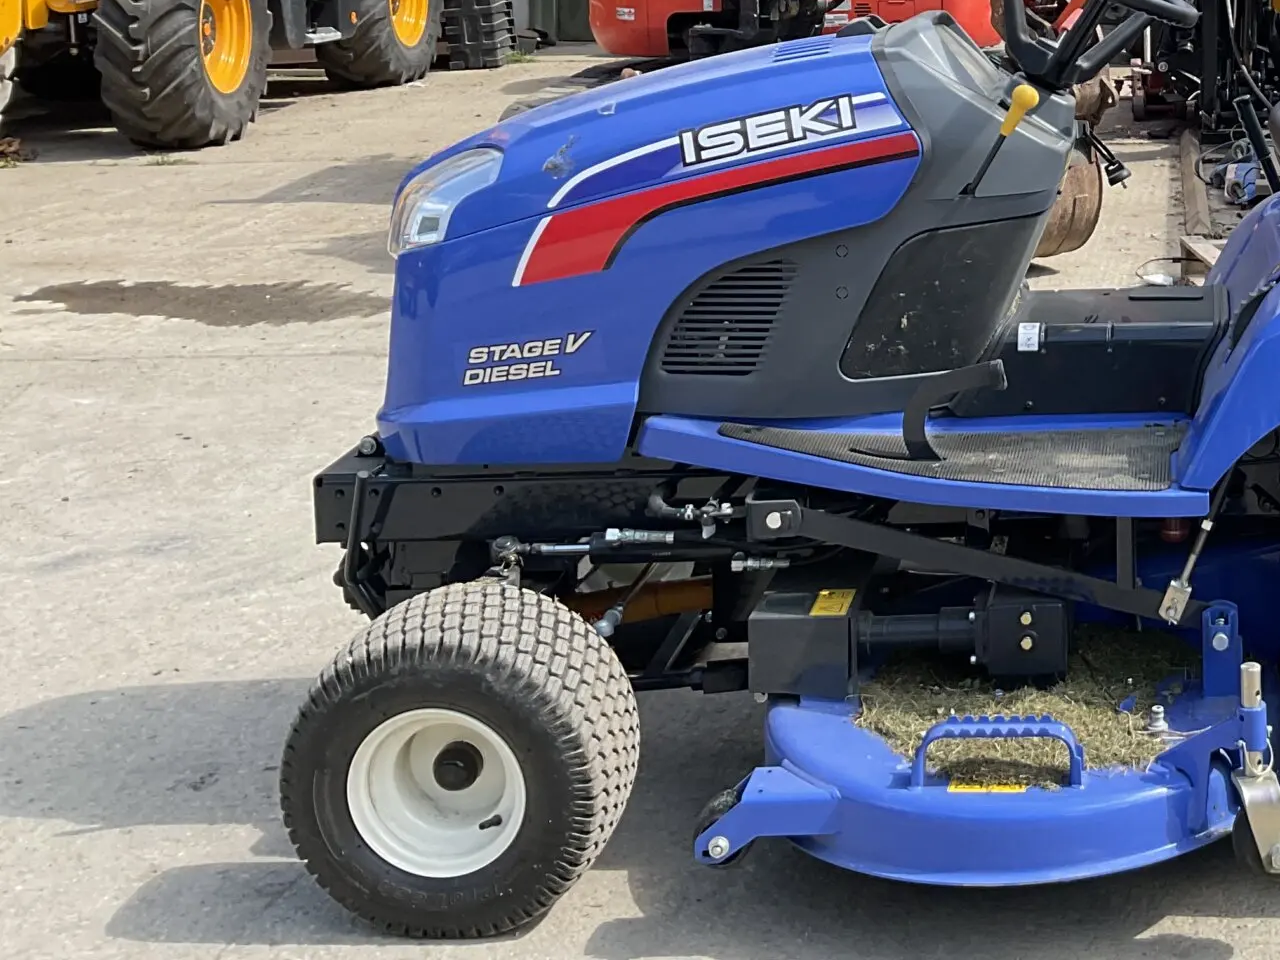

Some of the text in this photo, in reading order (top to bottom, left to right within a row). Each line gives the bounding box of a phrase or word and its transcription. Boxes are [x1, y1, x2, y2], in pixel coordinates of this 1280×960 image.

[680, 94, 855, 166] ISEKI
[468, 331, 594, 364] STAGE V
[463, 360, 561, 386] DIESEL
